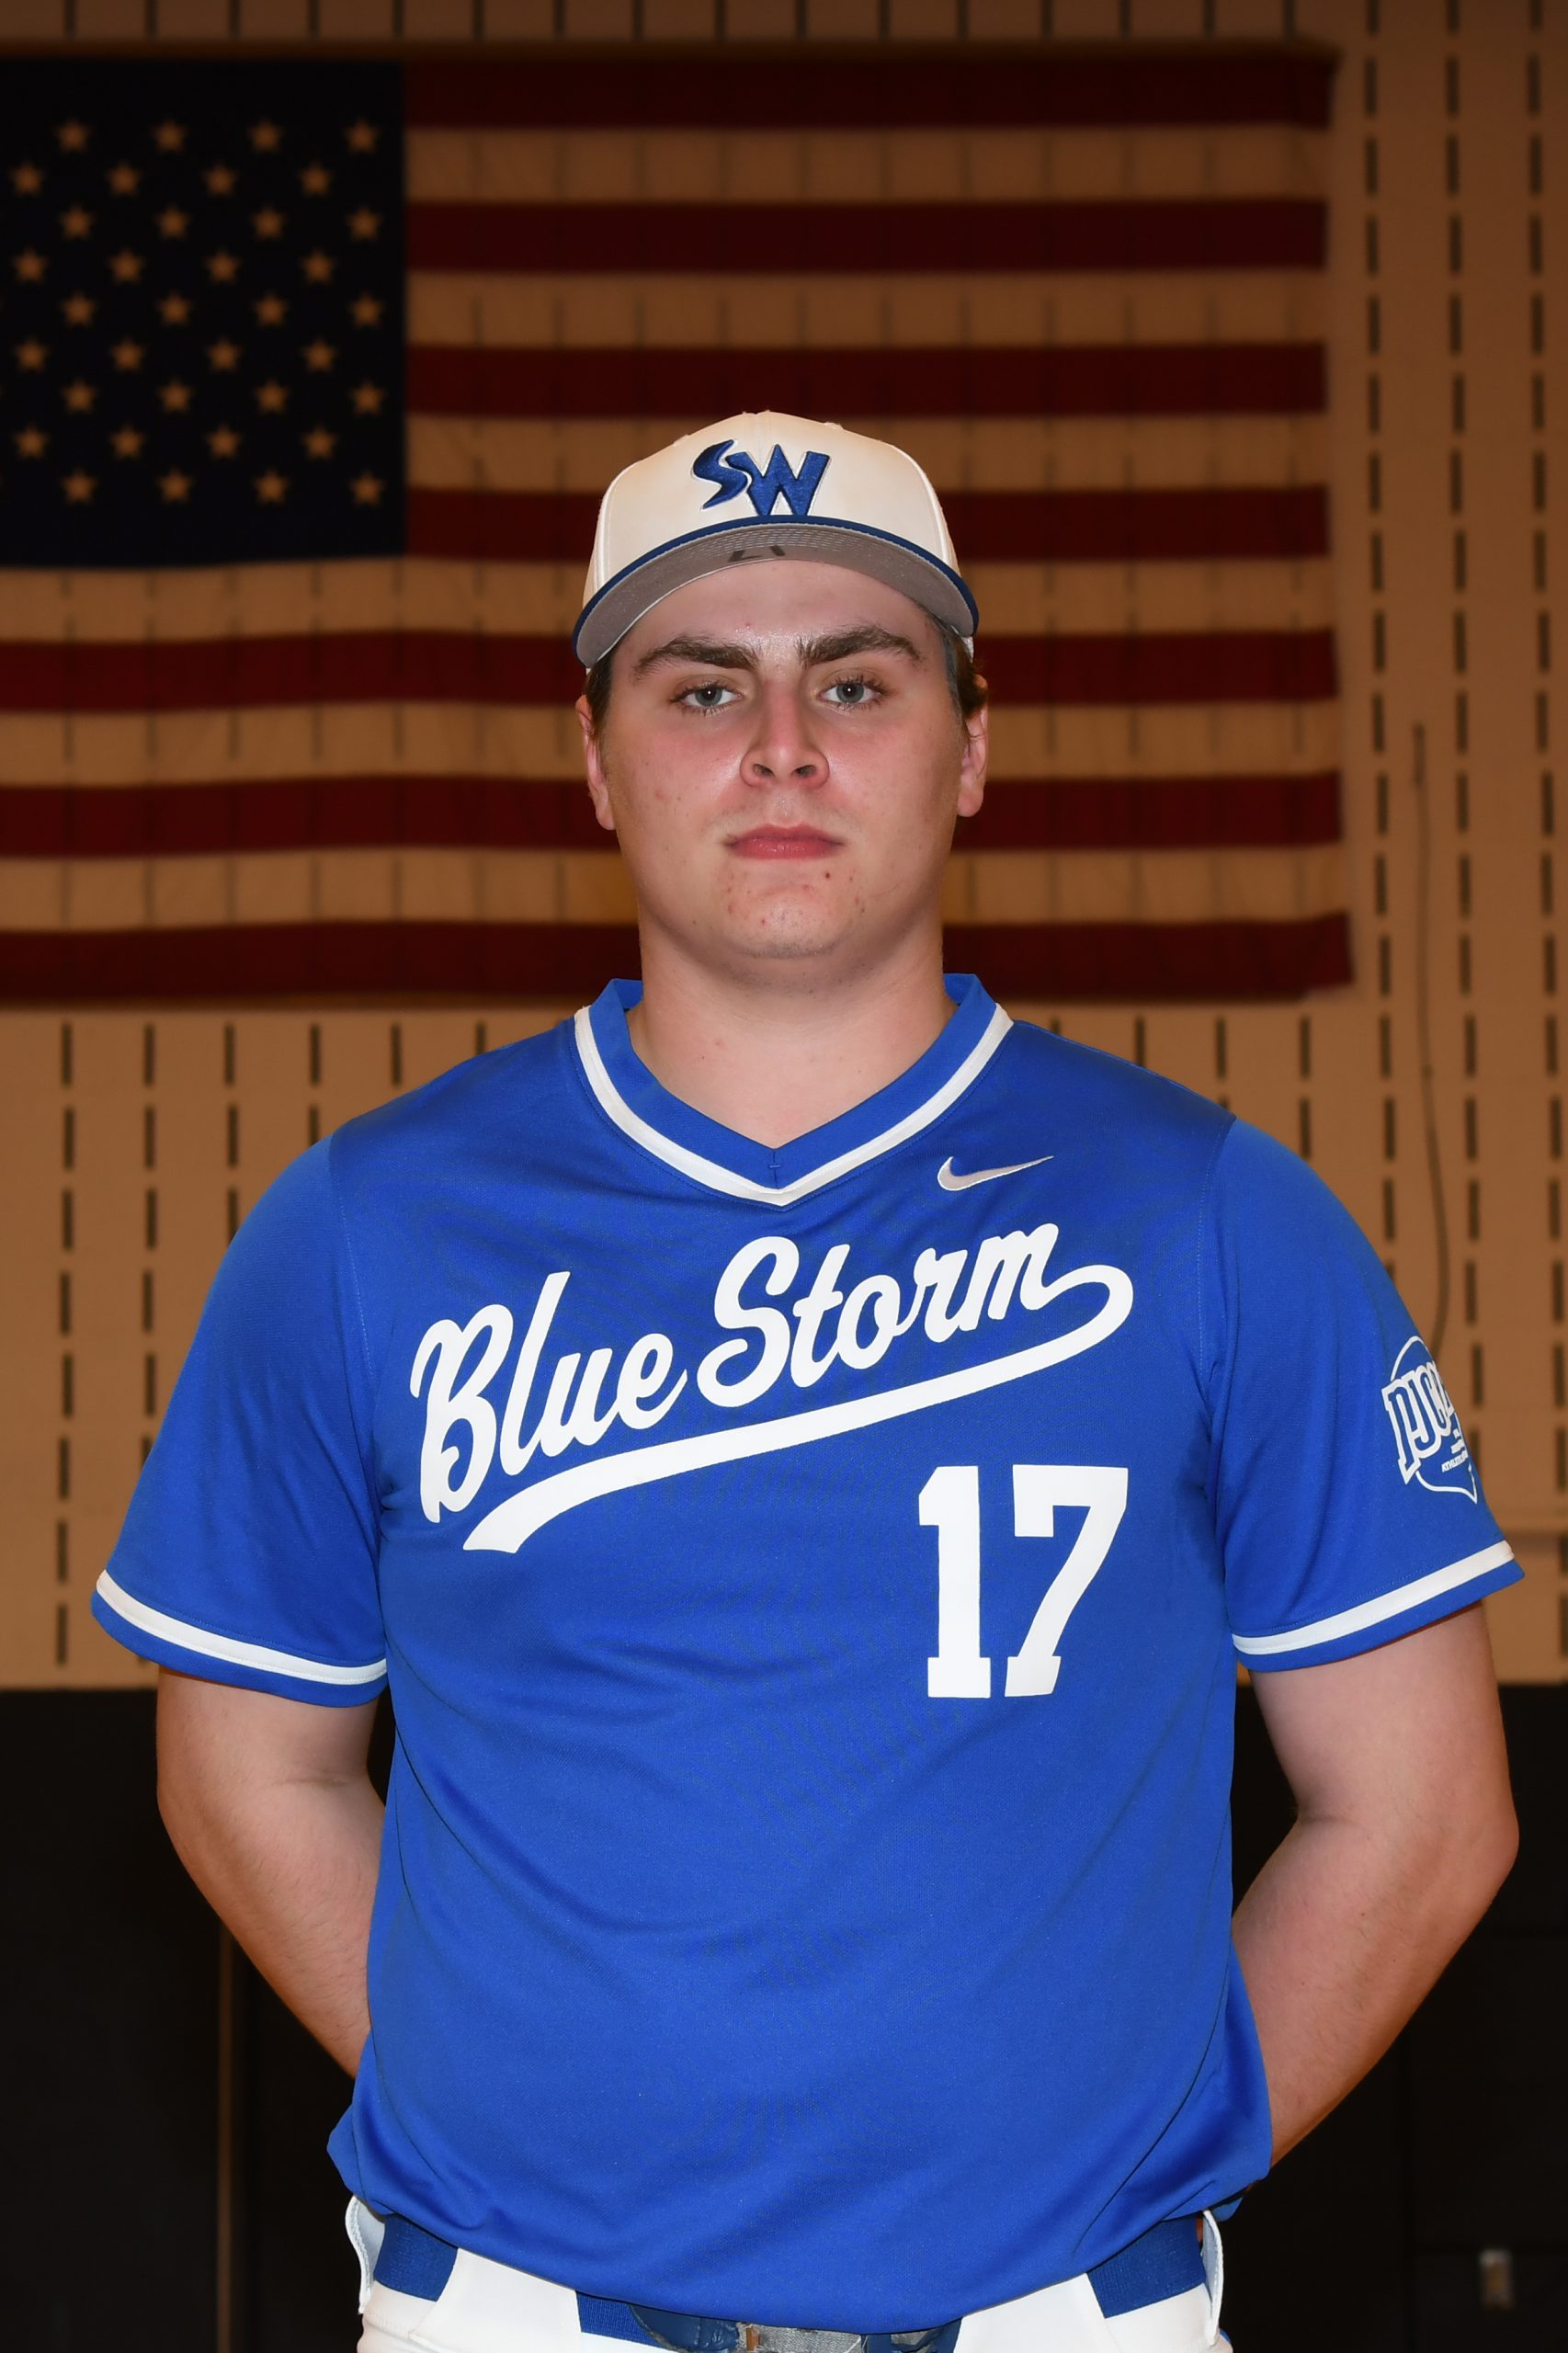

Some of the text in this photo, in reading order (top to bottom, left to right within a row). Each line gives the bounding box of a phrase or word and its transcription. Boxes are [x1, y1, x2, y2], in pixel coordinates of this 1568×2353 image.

[692, 438, 831, 517] SW
[409, 1222, 1068, 1523] Blue Storm
[918, 1464, 1129, 1699] 17
